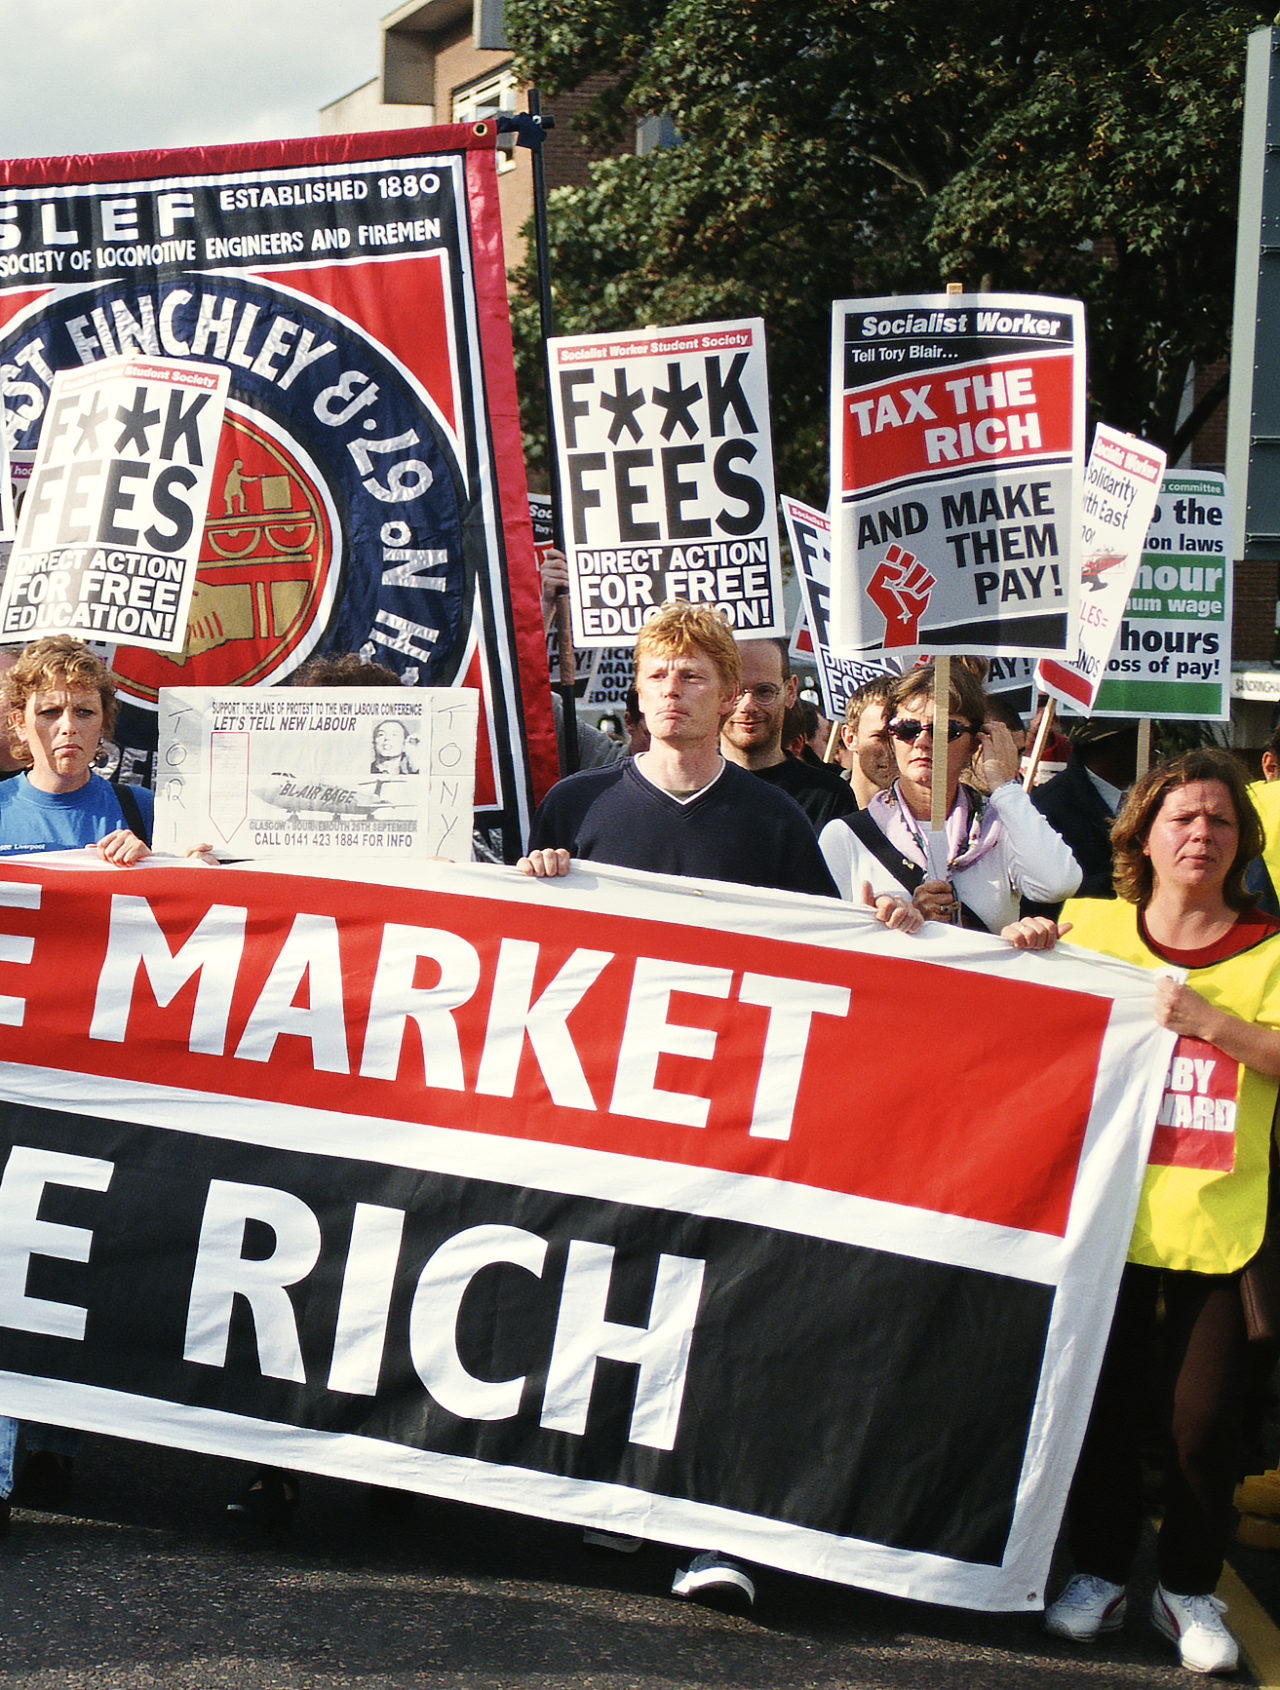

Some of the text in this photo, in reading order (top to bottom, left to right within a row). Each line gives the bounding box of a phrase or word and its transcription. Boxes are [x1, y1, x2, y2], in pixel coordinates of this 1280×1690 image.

[221, 174, 441, 211] ESTABLISHED 1880
[70, 247, 92, 270] OF
[96, 241, 196, 268] LOCOMOTIVE
[205, 231, 304, 259] ENGINEERS
[312, 229, 351, 250] AND
[359, 219, 441, 246] FIREMEN
[65, 290, 337, 390] FINCHLEY
[862, 312, 1061, 336] Socialist Worker
[561, 334, 748, 361] Socialist Worker Student Society
[852, 349, 875, 362] Tell
[878, 348, 905, 361] Tory
[125, 366, 217, 386] Student Society
[850, 368, 1036, 436] TAX THE
[924, 412, 1042, 464] RICH
[567, 438, 765, 544] FEES
[1089, 462, 1138, 507] Solidarity
[1169, 482, 1221, 494] committee
[22, 459, 198, 552] FEES
[858, 482, 1055, 550] AND MAKE
[1099, 500, 1128, 530] East
[1174, 498, 1223, 526] the
[578, 541, 766, 575] DIRECT ACTION
[946, 523, 1059, 568] THEM
[1179, 534, 1224, 552] laws
[20, 548, 88, 573] DIRECT
[90, 551, 184, 581] ACTION
[10, 570, 180, 613] FOR FREE
[580, 565, 769, 607] FOR FREE
[974, 564, 1062, 604] PAY!
[4, 603, 175, 636] EDUCATION!
[1168, 599, 1222, 620] wage
[1120, 621, 1220, 654] hours
[1148, 655, 1220, 680] of pay!
[212, 702, 422, 715] SUPPORT THE PLANE OF PROTEST TO THE NEW LABOUR CONFERENCE
[213, 716, 357, 731] LET'S TELL NEW LABOUR
[321, 786, 358, 804] RAGE
[14, 843, 46, 851] Liverpool
[254, 833, 413, 847] CALL 0141 423 1884 FOR INFO
[89, 893, 851, 1140] MARKET
[182, 1178, 706, 1451] RICH
